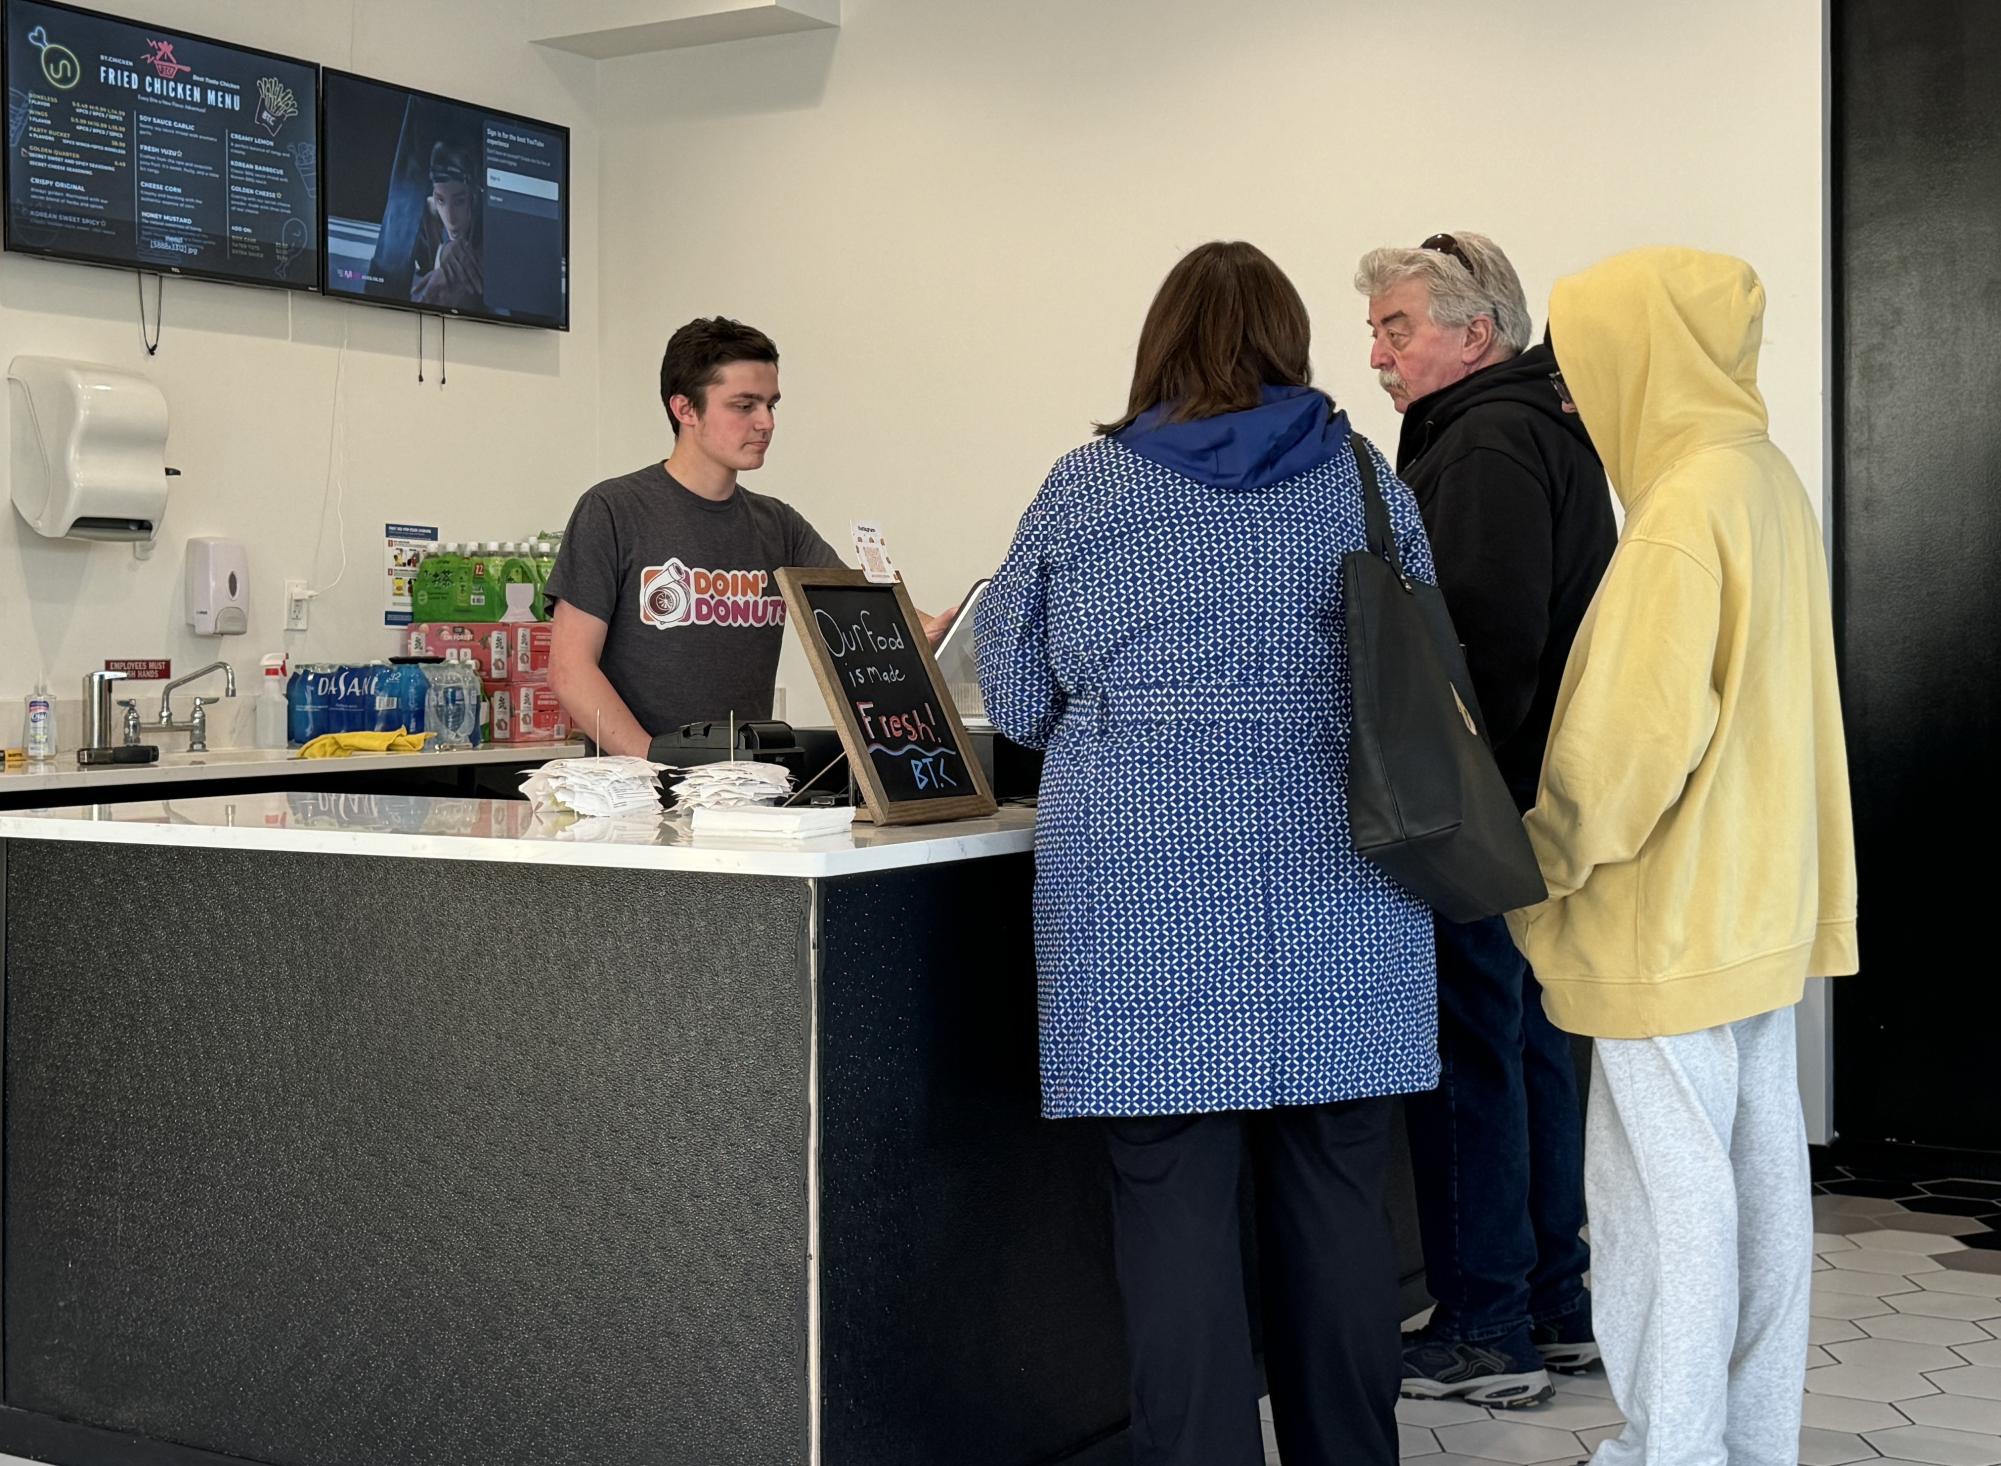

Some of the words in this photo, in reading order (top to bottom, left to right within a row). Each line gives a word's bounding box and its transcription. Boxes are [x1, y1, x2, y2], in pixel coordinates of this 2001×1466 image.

[100, 66, 138, 90] FRIED
[145, 76, 201, 103] CHICKEN
[207, 89, 240, 111] MENU
[29, 126, 48, 134] PARTY
[139, 114, 152, 122] SOY
[152, 117, 173, 127] SAUCE
[173, 121, 196, 131] GARLIC
[230, 132, 254, 142] CREAMY
[254, 138, 274, 147] LEMON
[140, 144, 160, 153] FRESH
[230, 160, 254, 169] KOREAN
[254, 164, 284, 175] BARBECUE
[30, 177, 54, 187] CRISPY
[54, 181, 86, 192] ORIGINAL
[140, 181, 163, 191] CHEESE
[164, 185, 182, 193] CORN
[230, 185, 254, 195] GOLDEN
[254, 189, 276, 199] CHEESE
[142, 211, 162, 220] HONEY
[163, 215, 193, 224] MUSTARD
[693, 570, 768, 598] DOIN'
[813, 608, 864, 658] Our
[110, 662, 146, 670] EMPLOYEES
[137, 670, 160, 678] HANDS
[844, 661, 865, 688] is
[317, 671, 378, 700] DASANI
[856, 701, 942, 744] Fresh!
